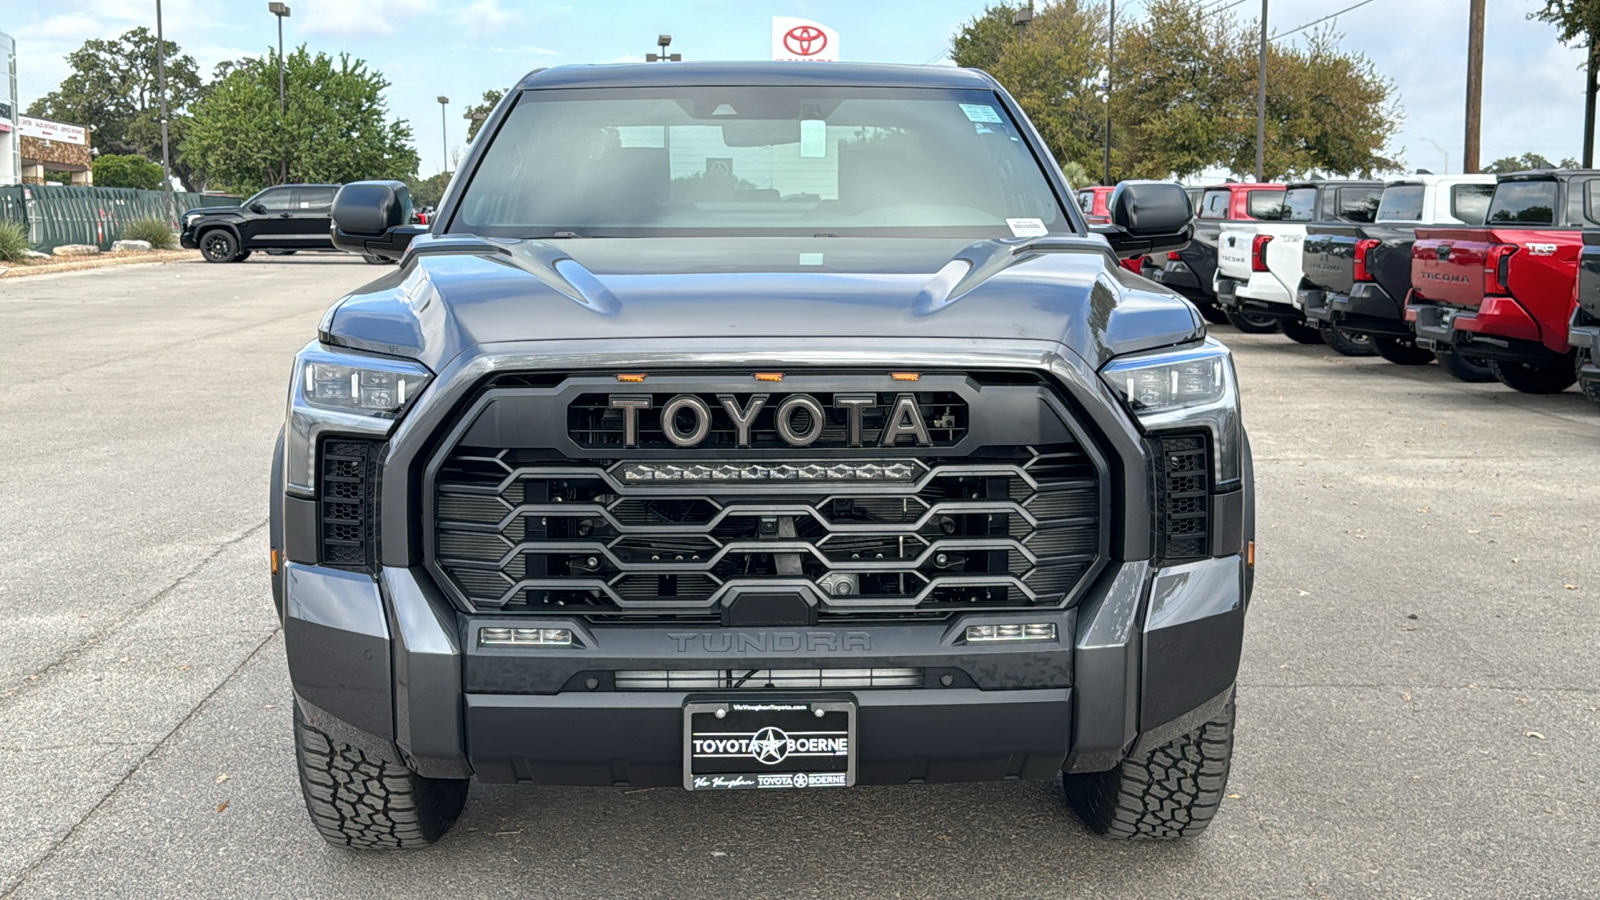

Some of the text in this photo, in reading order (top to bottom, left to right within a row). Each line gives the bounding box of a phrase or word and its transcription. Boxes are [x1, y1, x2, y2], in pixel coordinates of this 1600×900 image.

[1525, 243, 1557, 253] TRD
[1221, 255, 1246, 263] TACOMA
[1420, 271, 1470, 285] TACOMA
[608, 393, 934, 448] TOYOTA
[666, 631, 872, 653] TUNDRA
[732, 704, 808, 712] VicVaughanToyota.com
[693, 739, 760, 753] TOYOTA
[787, 738, 848, 751] BOERNE
[758, 776, 793, 786] TOYOTA
[808, 775, 845, 784] BOERNE
